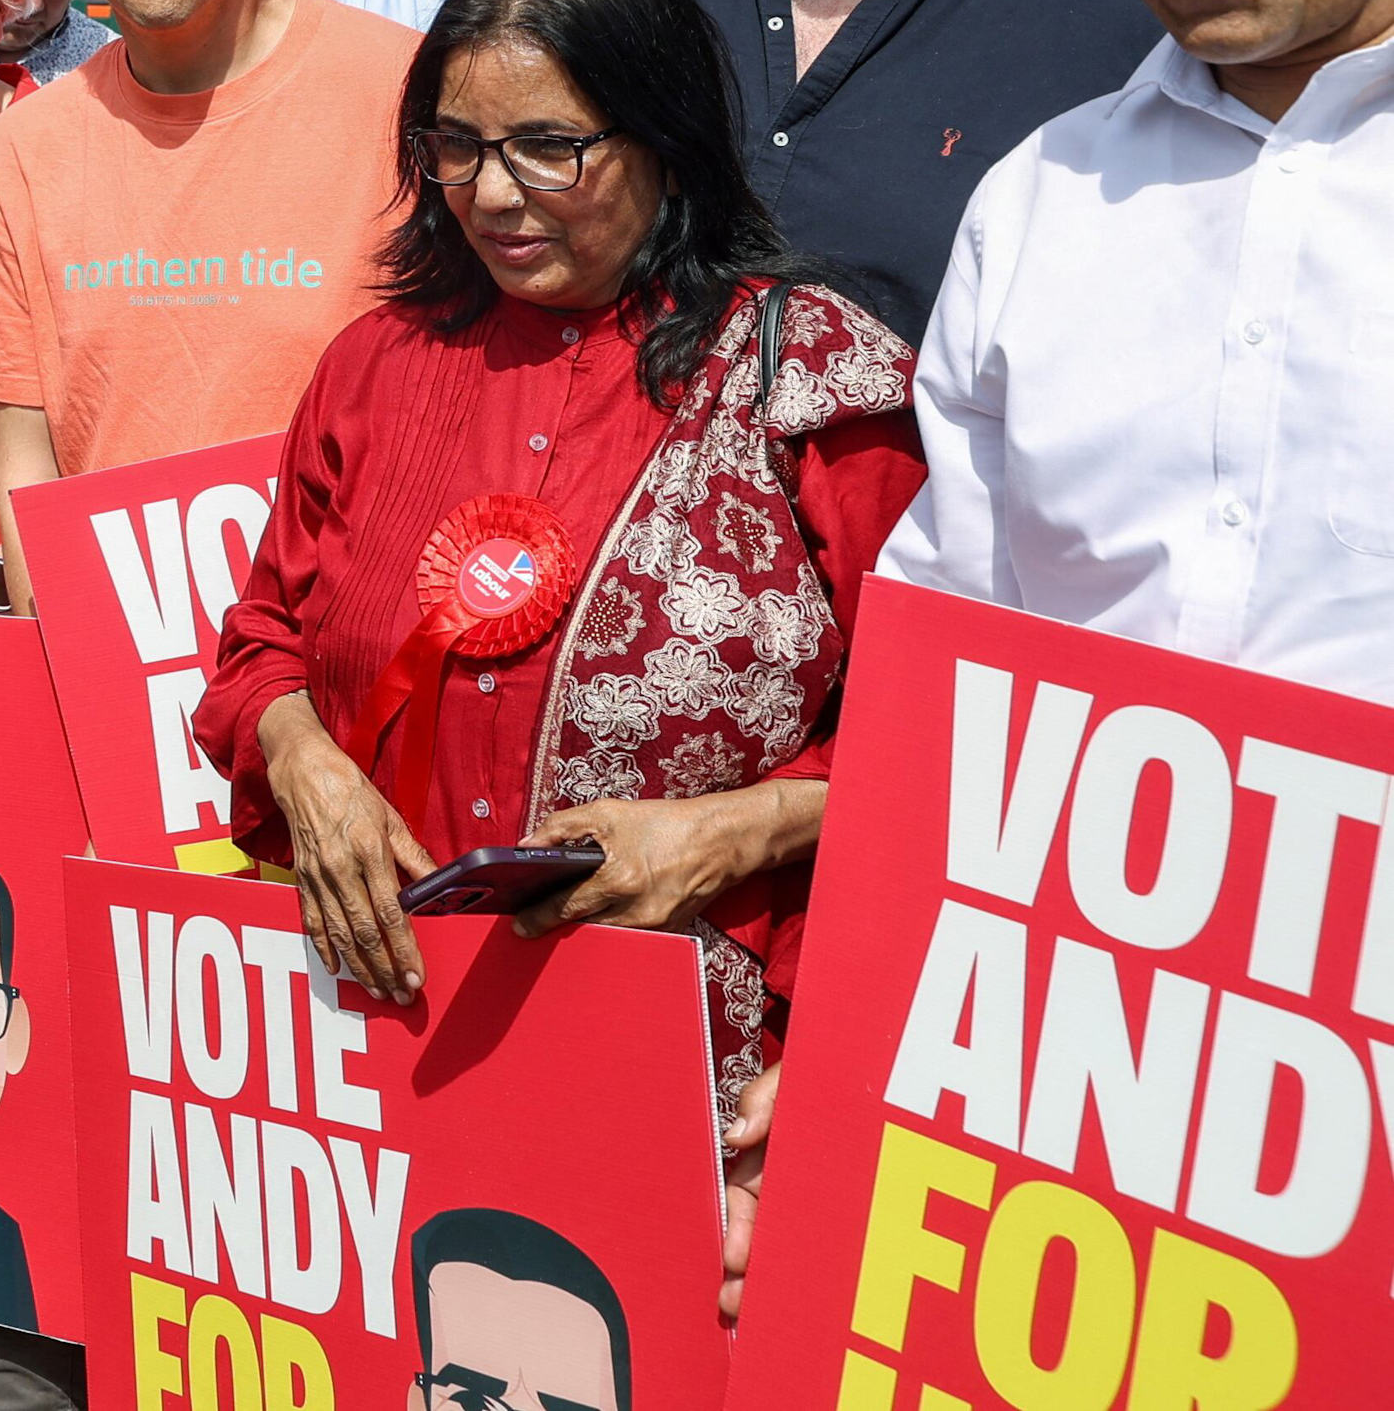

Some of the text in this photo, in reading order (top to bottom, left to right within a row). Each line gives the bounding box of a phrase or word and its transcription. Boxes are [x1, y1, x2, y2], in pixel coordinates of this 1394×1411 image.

[65, 248, 324, 290] northern tide
[90, 476, 278, 665] VO
[468, 562, 511, 600] Labour
[946, 658, 1394, 1027] VOT
[109, 905, 382, 1132] VOTE
[883, 897, 1394, 1298] AND
[126, 1089, 410, 1340] ANDY
[850, 1120, 1299, 1411] FOR
